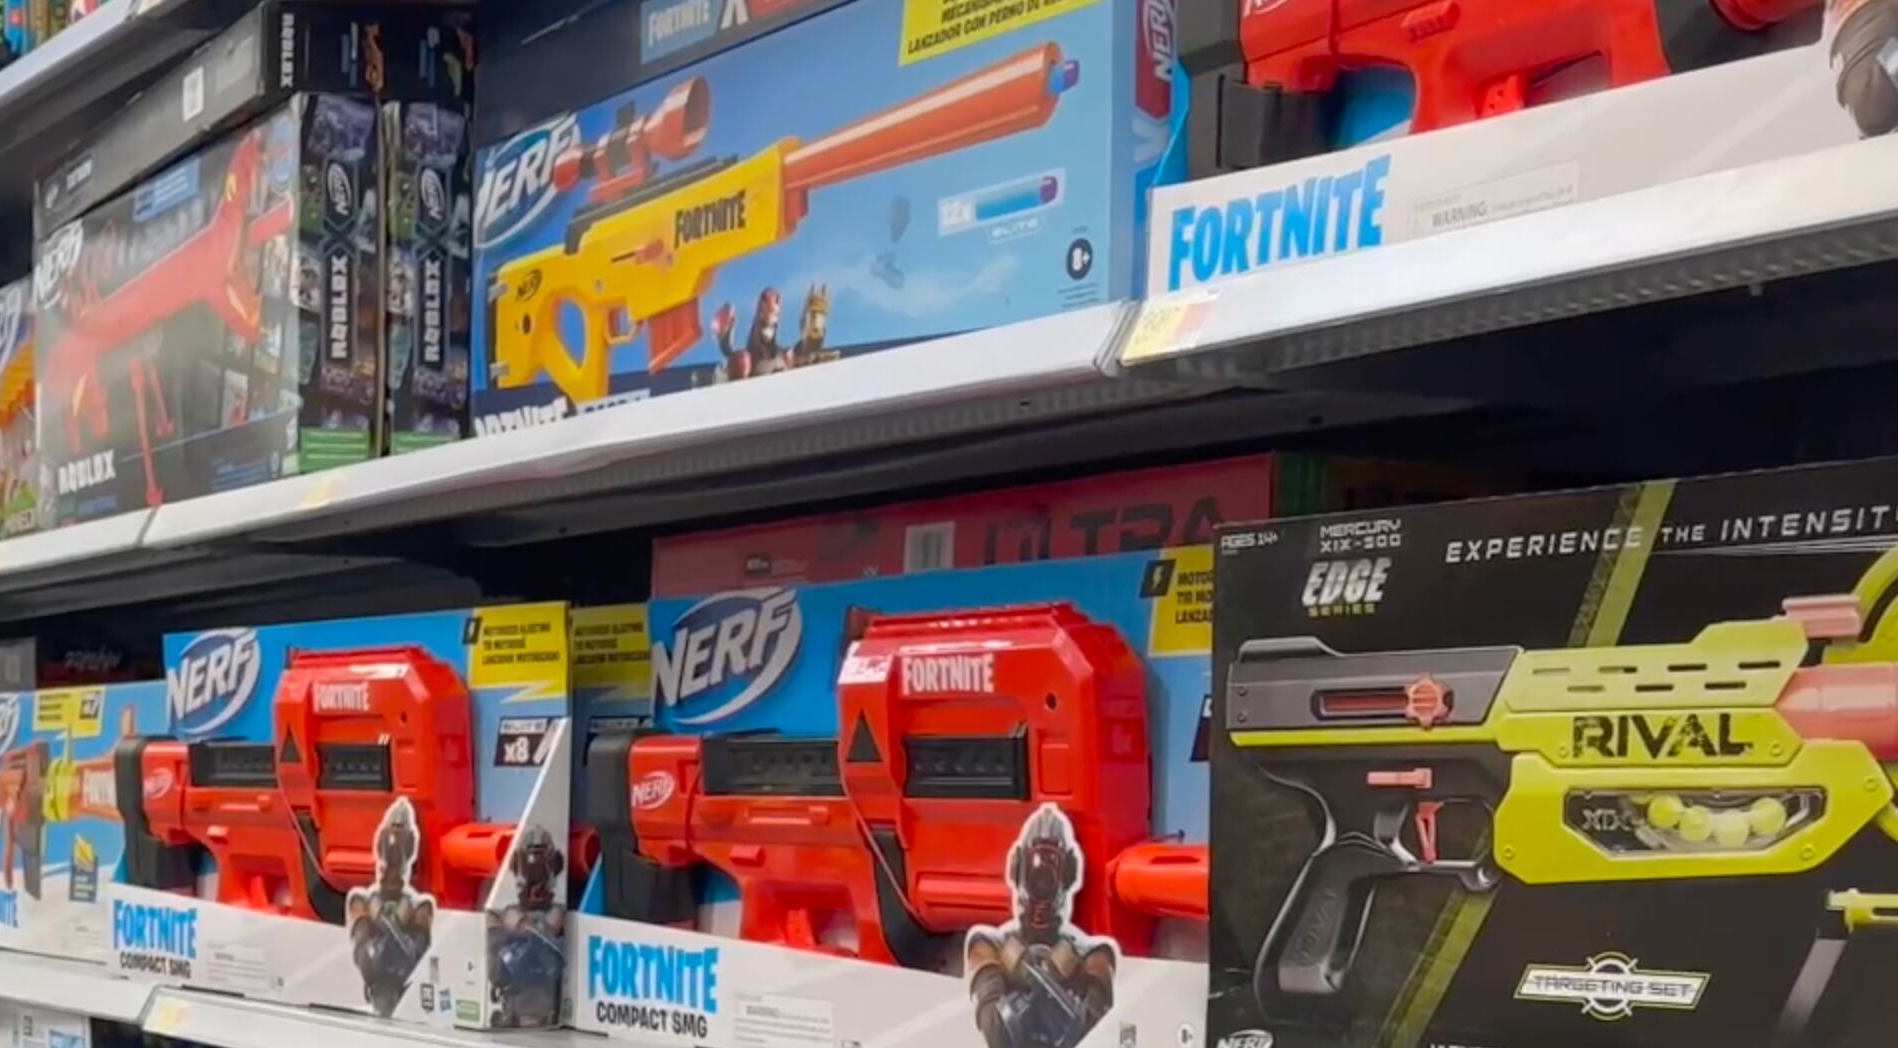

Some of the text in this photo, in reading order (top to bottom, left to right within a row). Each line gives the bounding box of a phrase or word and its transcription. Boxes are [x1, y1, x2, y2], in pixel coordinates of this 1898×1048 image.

[648, 3, 710, 46] FORTNITE
[907, 22, 961, 54] LANZADOR
[674, 190, 746, 249] FORTNITE
[1168, 154, 1391, 292] FORTNITE
[34, 219, 83, 304] NERF
[1072, 247, 1091, 272] 8+
[331, 256, 348, 358] ROBLOX
[425, 260, 441, 362] ROBLOX
[58, 449, 117, 495] ROBLOX
[1221, 534, 1255, 549] AGES
[1320, 519, 1402, 538] MERCURY
[1445, 505, 1898, 563] EXPERIENCE THE INTENSIT
[1302, 557, 1392, 607] EDGE
[1308, 603, 1376, 618] SERIES
[651, 588, 799, 706] NERF
[168, 631, 258, 719] NERF
[313, 683, 369, 711] FORTNITE
[902, 653, 995, 695] FORTNITE
[504, 738, 529, 763] x8
[1572, 713, 1754, 759] RIVAL
[631, 774, 675, 808] NERF
[113, 901, 197, 959] FORTNITE
[588, 935, 719, 1014] FORTNITE
[1533, 974, 1692, 997] TARGETING SET
[596, 1001, 667, 1030] COMPACT
[672, 1013, 707, 1039] SMG
